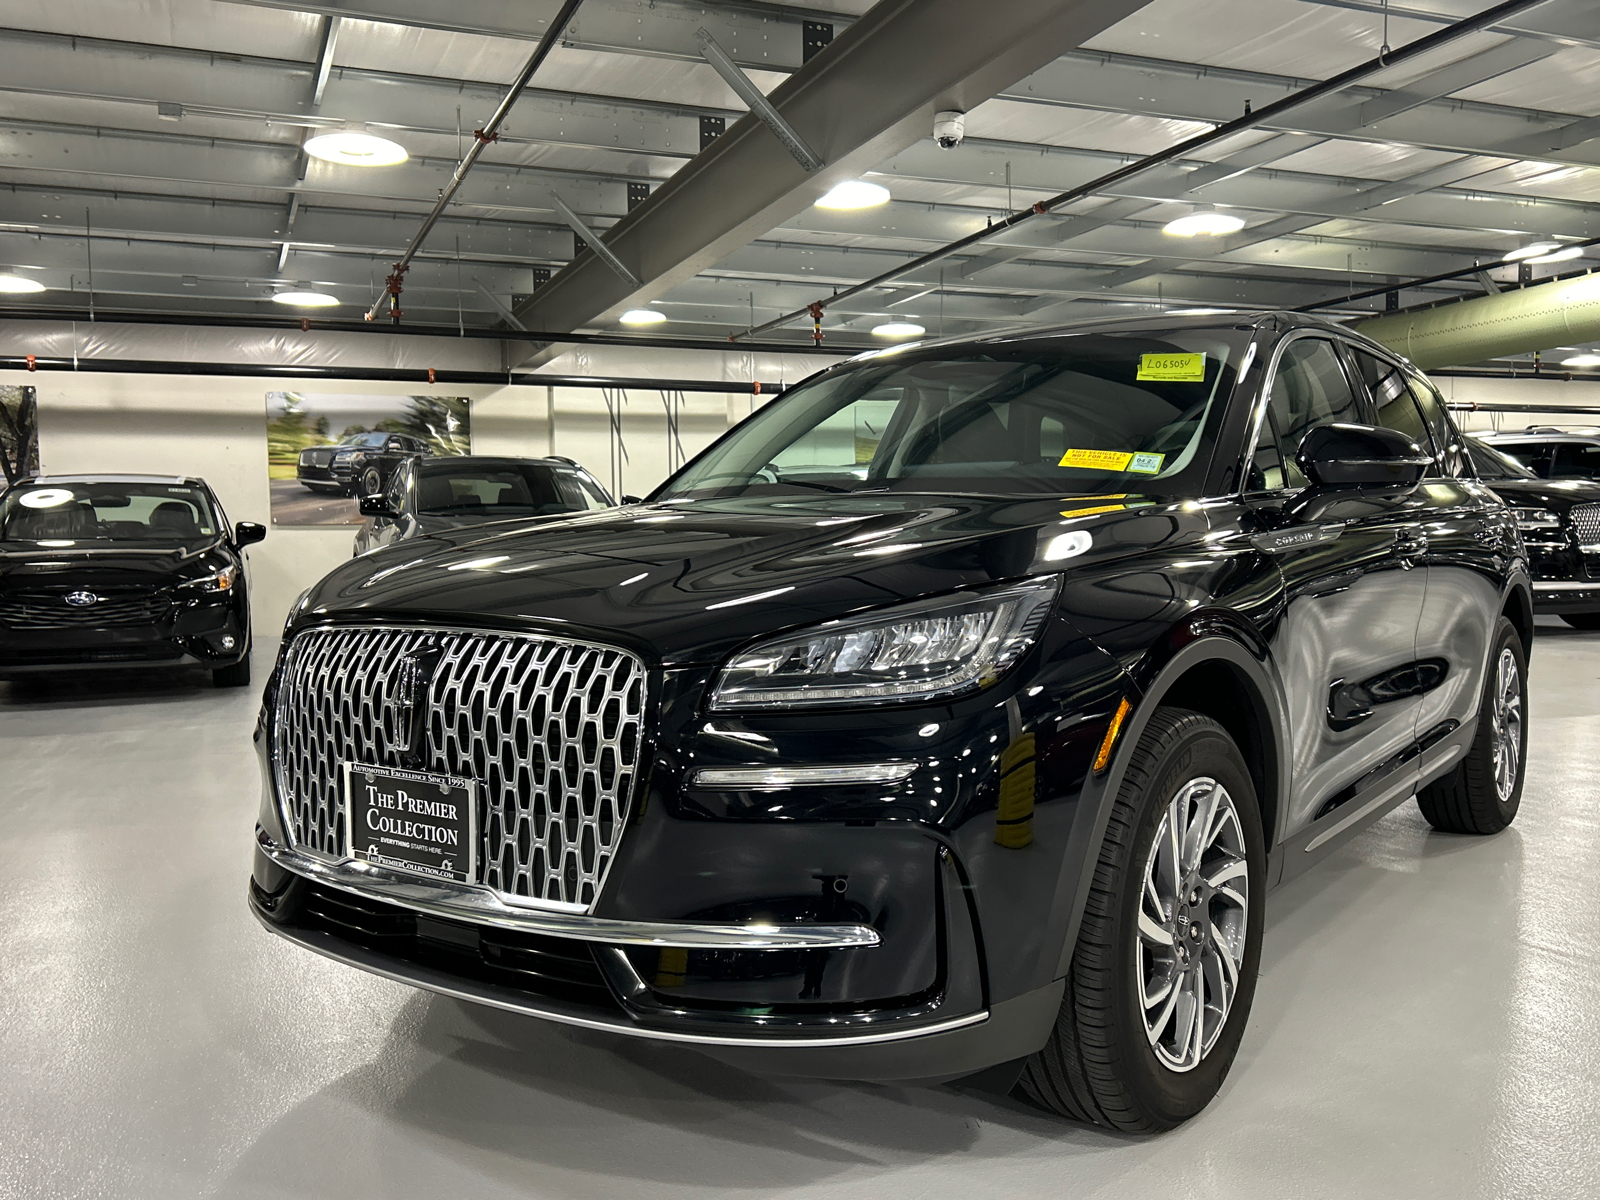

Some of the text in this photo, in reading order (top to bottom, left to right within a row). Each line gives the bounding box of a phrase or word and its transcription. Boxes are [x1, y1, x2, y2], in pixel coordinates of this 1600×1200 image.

[354, 765, 465, 788] AUTOMOTIVE EXCELLENCE SINCE 1995
[365, 784, 459, 821] THE PREMIER
[366, 808, 459, 846] COLLECTION
[380, 836, 411, 849] EVERYTHING
[410, 842, 429, 853] STARTS
